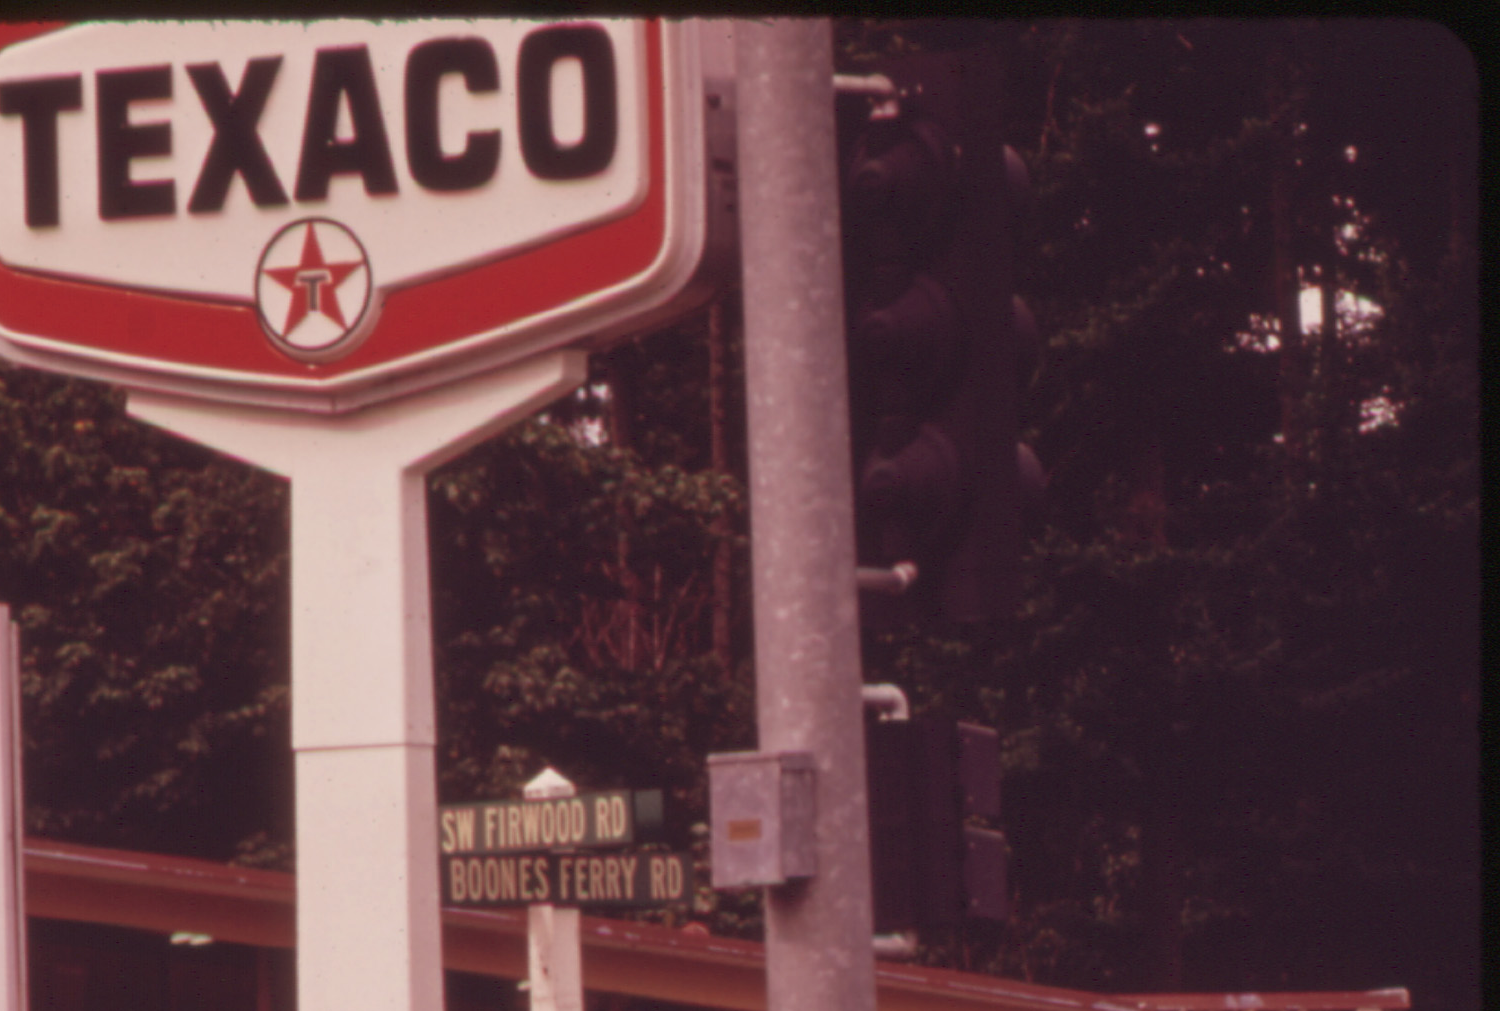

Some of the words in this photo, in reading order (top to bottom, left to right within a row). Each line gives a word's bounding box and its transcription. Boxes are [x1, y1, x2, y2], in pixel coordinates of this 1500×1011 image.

[299, 273, 327, 311] T
[441, 809, 475, 854] SW
[484, 798, 585, 850] FIRWOOD
[595, 795, 627, 841] RD
[451, 857, 549, 900] BOONES
[560, 856, 637, 899] FERRY
[651, 855, 684, 899] RD
